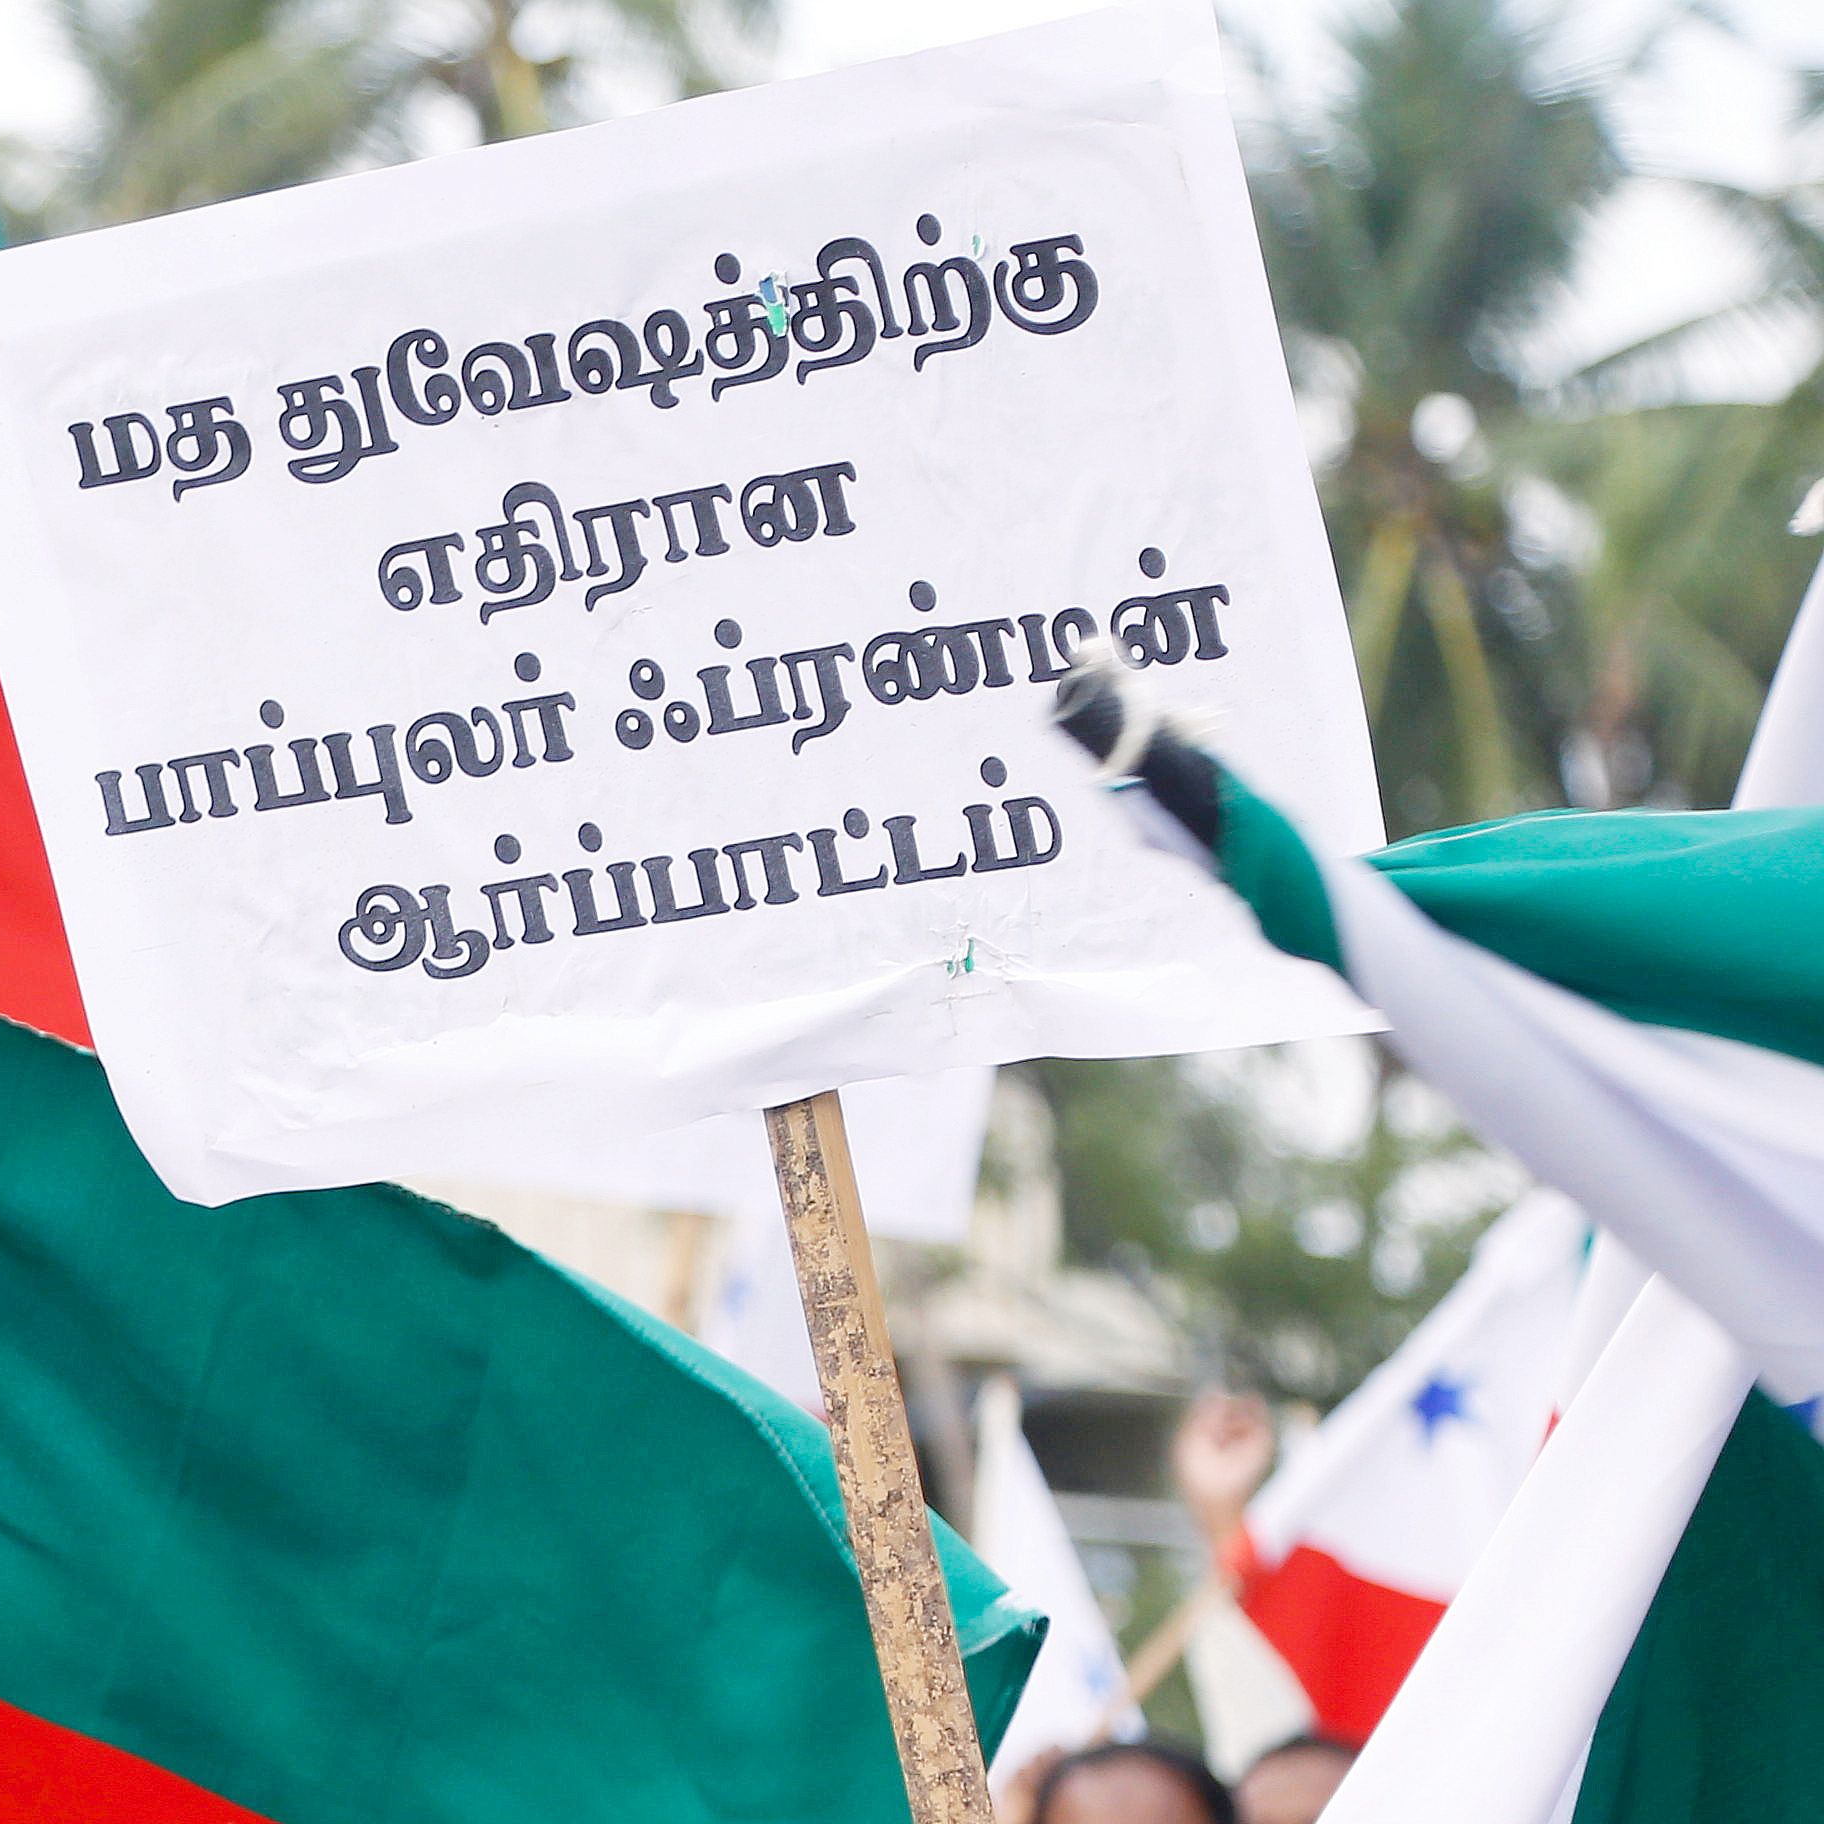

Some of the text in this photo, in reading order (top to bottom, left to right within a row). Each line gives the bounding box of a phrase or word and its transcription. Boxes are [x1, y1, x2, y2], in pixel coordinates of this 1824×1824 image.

[66, 212, 1100, 504] மத துவேஷத்திற்கு
[376, 459, 858, 627] எதிரான
[93, 651, 577, 838] பாப்புலர்
[336, 755, 1063, 981] ஆர்ப்பாட்டம்
